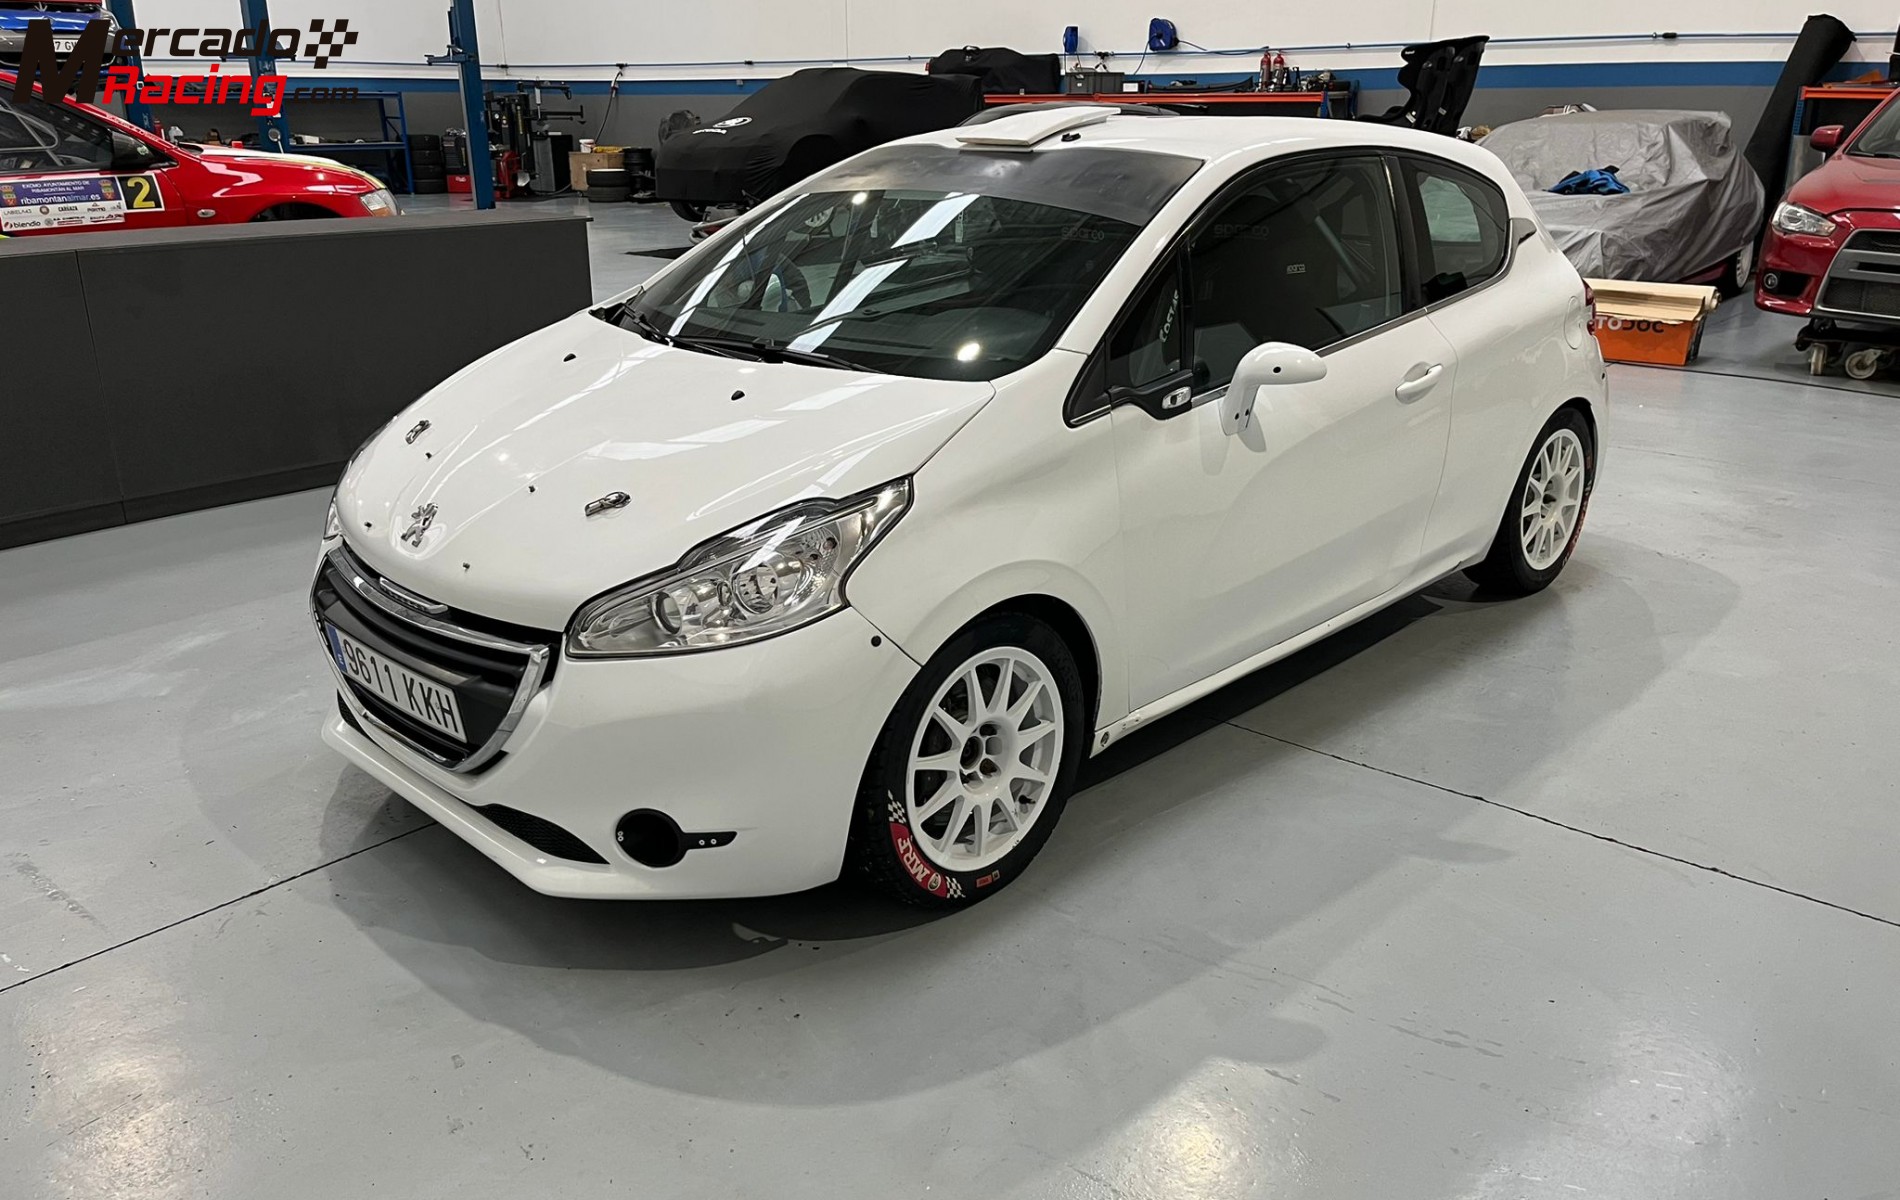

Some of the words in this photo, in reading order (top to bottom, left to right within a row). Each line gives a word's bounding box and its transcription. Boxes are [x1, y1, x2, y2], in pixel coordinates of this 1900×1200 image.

[20, 193, 101, 204] ribamontanalmar.es
[127, 177, 155, 208] 2
[1214, 223, 1270, 237] sparco
[1595, 316, 1664, 333] TODOC
[343, 639, 399, 702] 9611
[402, 673, 459, 733] KKH
[897, 837, 930, 882] MRF
